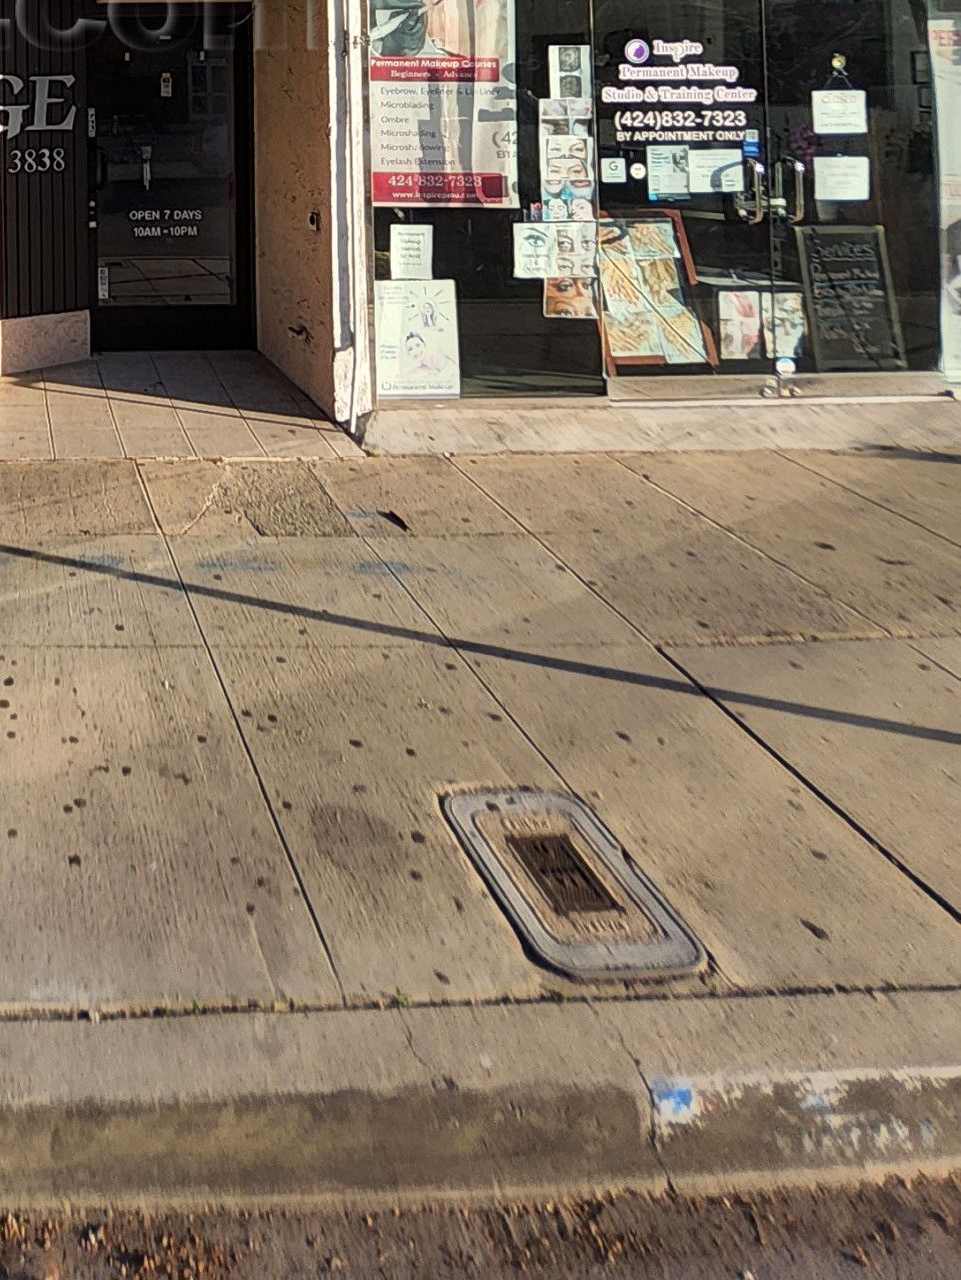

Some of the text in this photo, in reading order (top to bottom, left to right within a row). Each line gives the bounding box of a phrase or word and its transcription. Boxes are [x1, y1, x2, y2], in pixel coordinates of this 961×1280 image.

[655, 41, 701, 60] Inspire
[370, 60, 418, 68] Permanent
[420, 60, 459, 69] Makeup
[621, 66, 736, 81] Permanent Makeup
[604, 88, 755, 102] Studio & Training Center
[615, 111, 747, 130] (424)832-7323
[617, 131, 744, 140] BY APPOINTMENT ONLY
[8, 148, 66, 173] 3838
[388, 174, 482, 187] 424-832-7323
[129, 209, 202, 220] OPEN 7 DAYS
[133, 226, 161, 237] 10AM
[170, 225, 198, 236] 10PM
